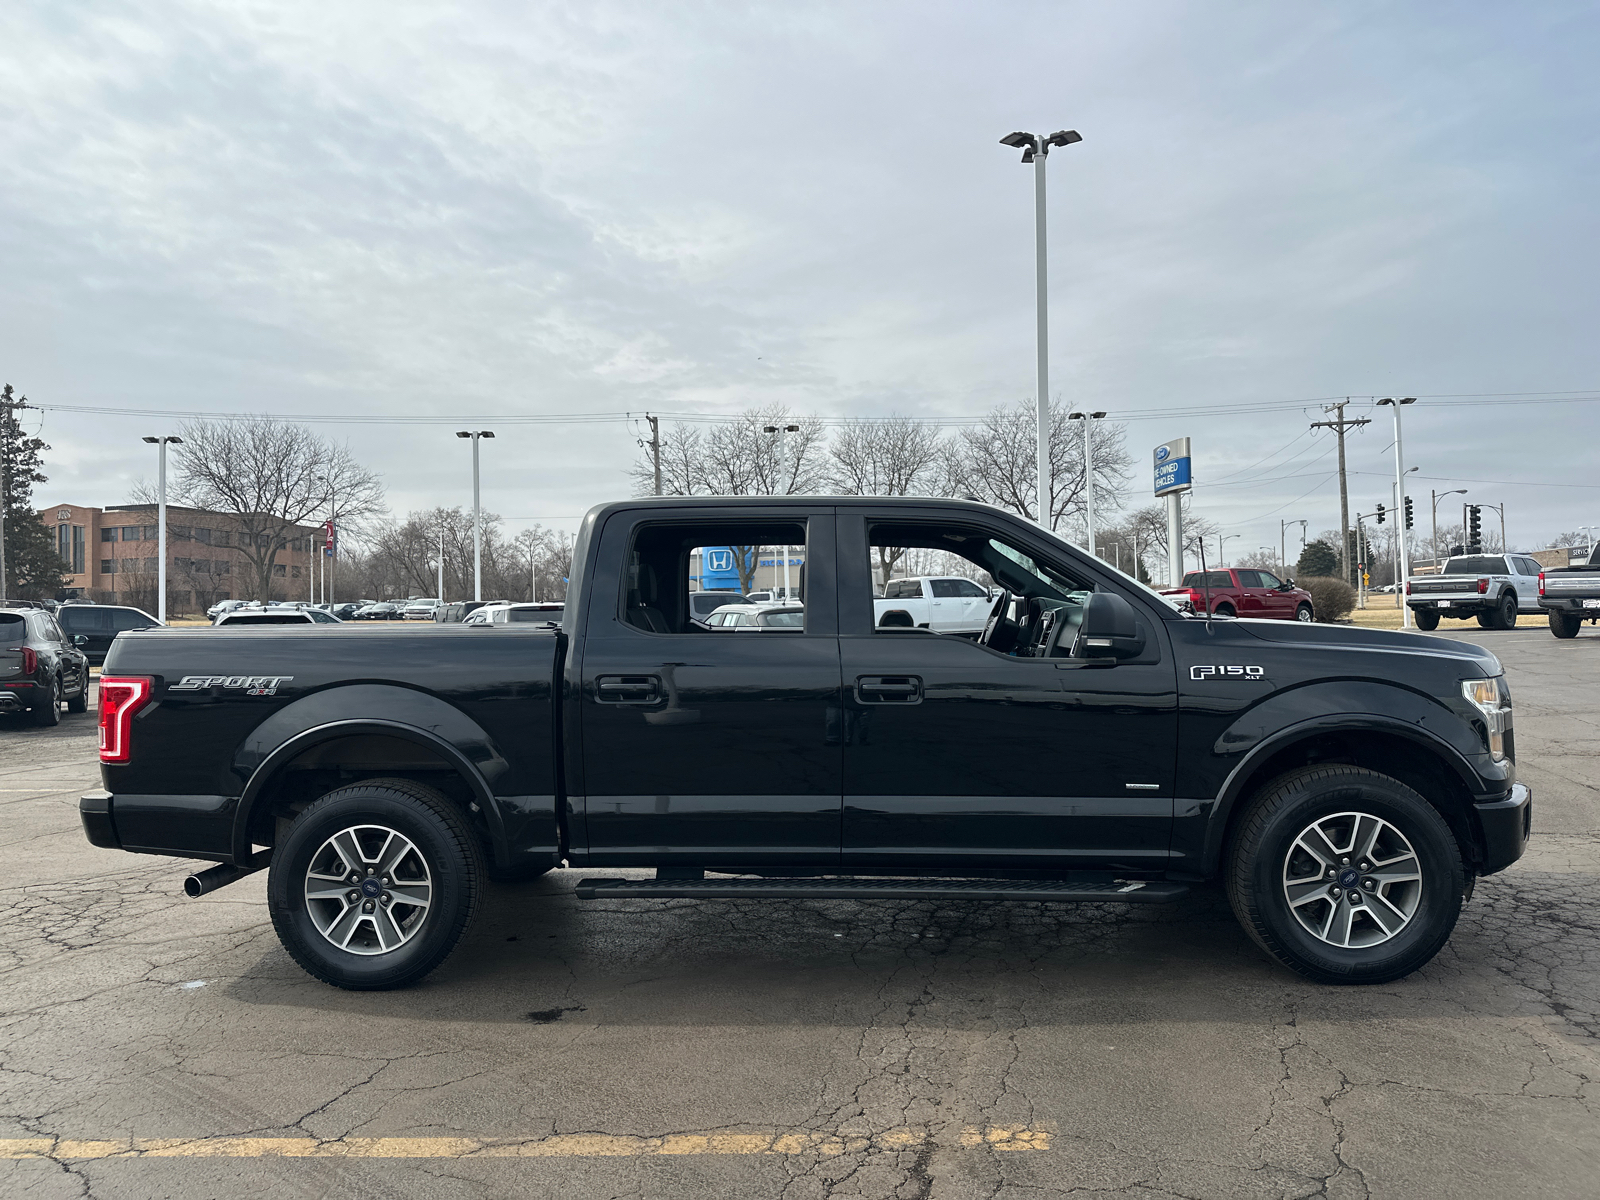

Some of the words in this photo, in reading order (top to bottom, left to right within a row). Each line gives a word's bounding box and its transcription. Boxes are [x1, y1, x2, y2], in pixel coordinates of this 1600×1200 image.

[1154, 462, 1179, 478] E-OWNED
[1156, 474, 1175, 488] EHICLES
[1572, 548, 1590, 556] SERVIC
[760, 559, 803, 567] HONDA
[168, 675, 295, 691] SPORT
